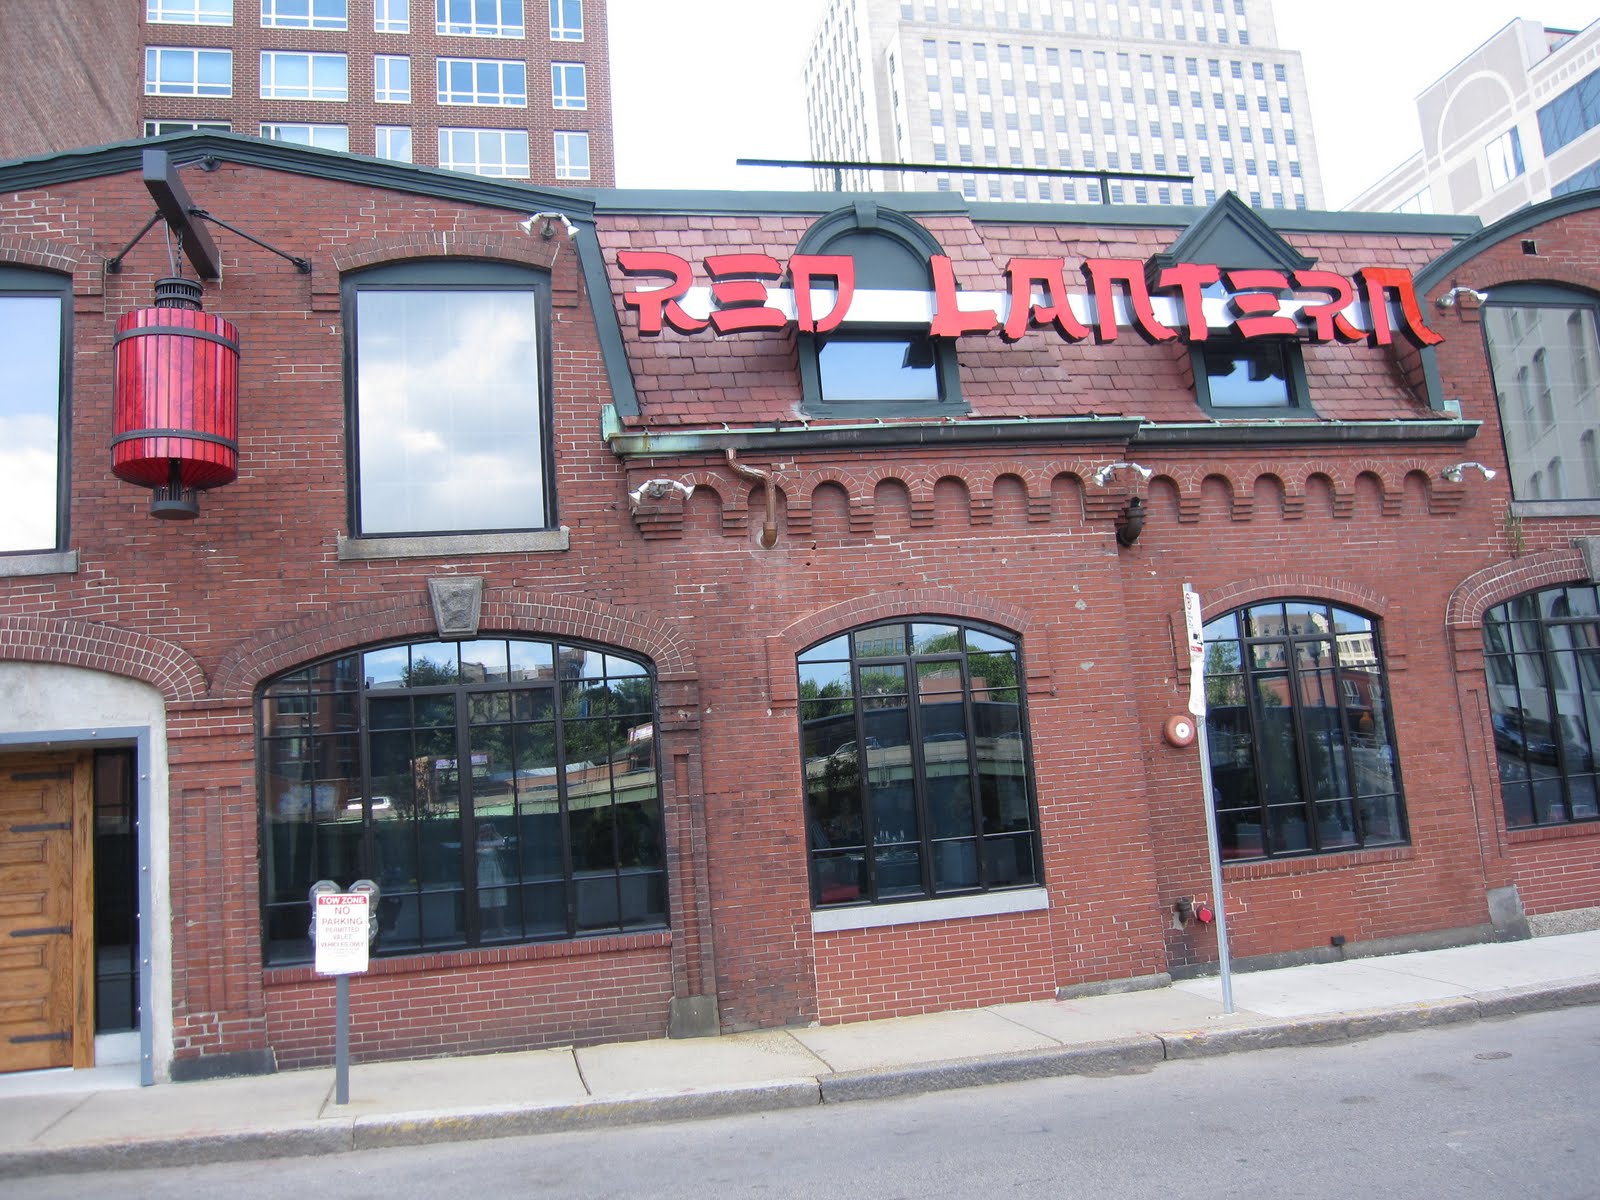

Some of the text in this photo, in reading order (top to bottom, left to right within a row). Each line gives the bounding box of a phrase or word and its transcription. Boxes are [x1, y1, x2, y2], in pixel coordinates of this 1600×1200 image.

[616, 250, 1445, 349] RED LANTERN
[341, 896, 365, 904] ZONE
[334, 906, 351, 915] NO
[321, 917, 363, 926] PARKING
